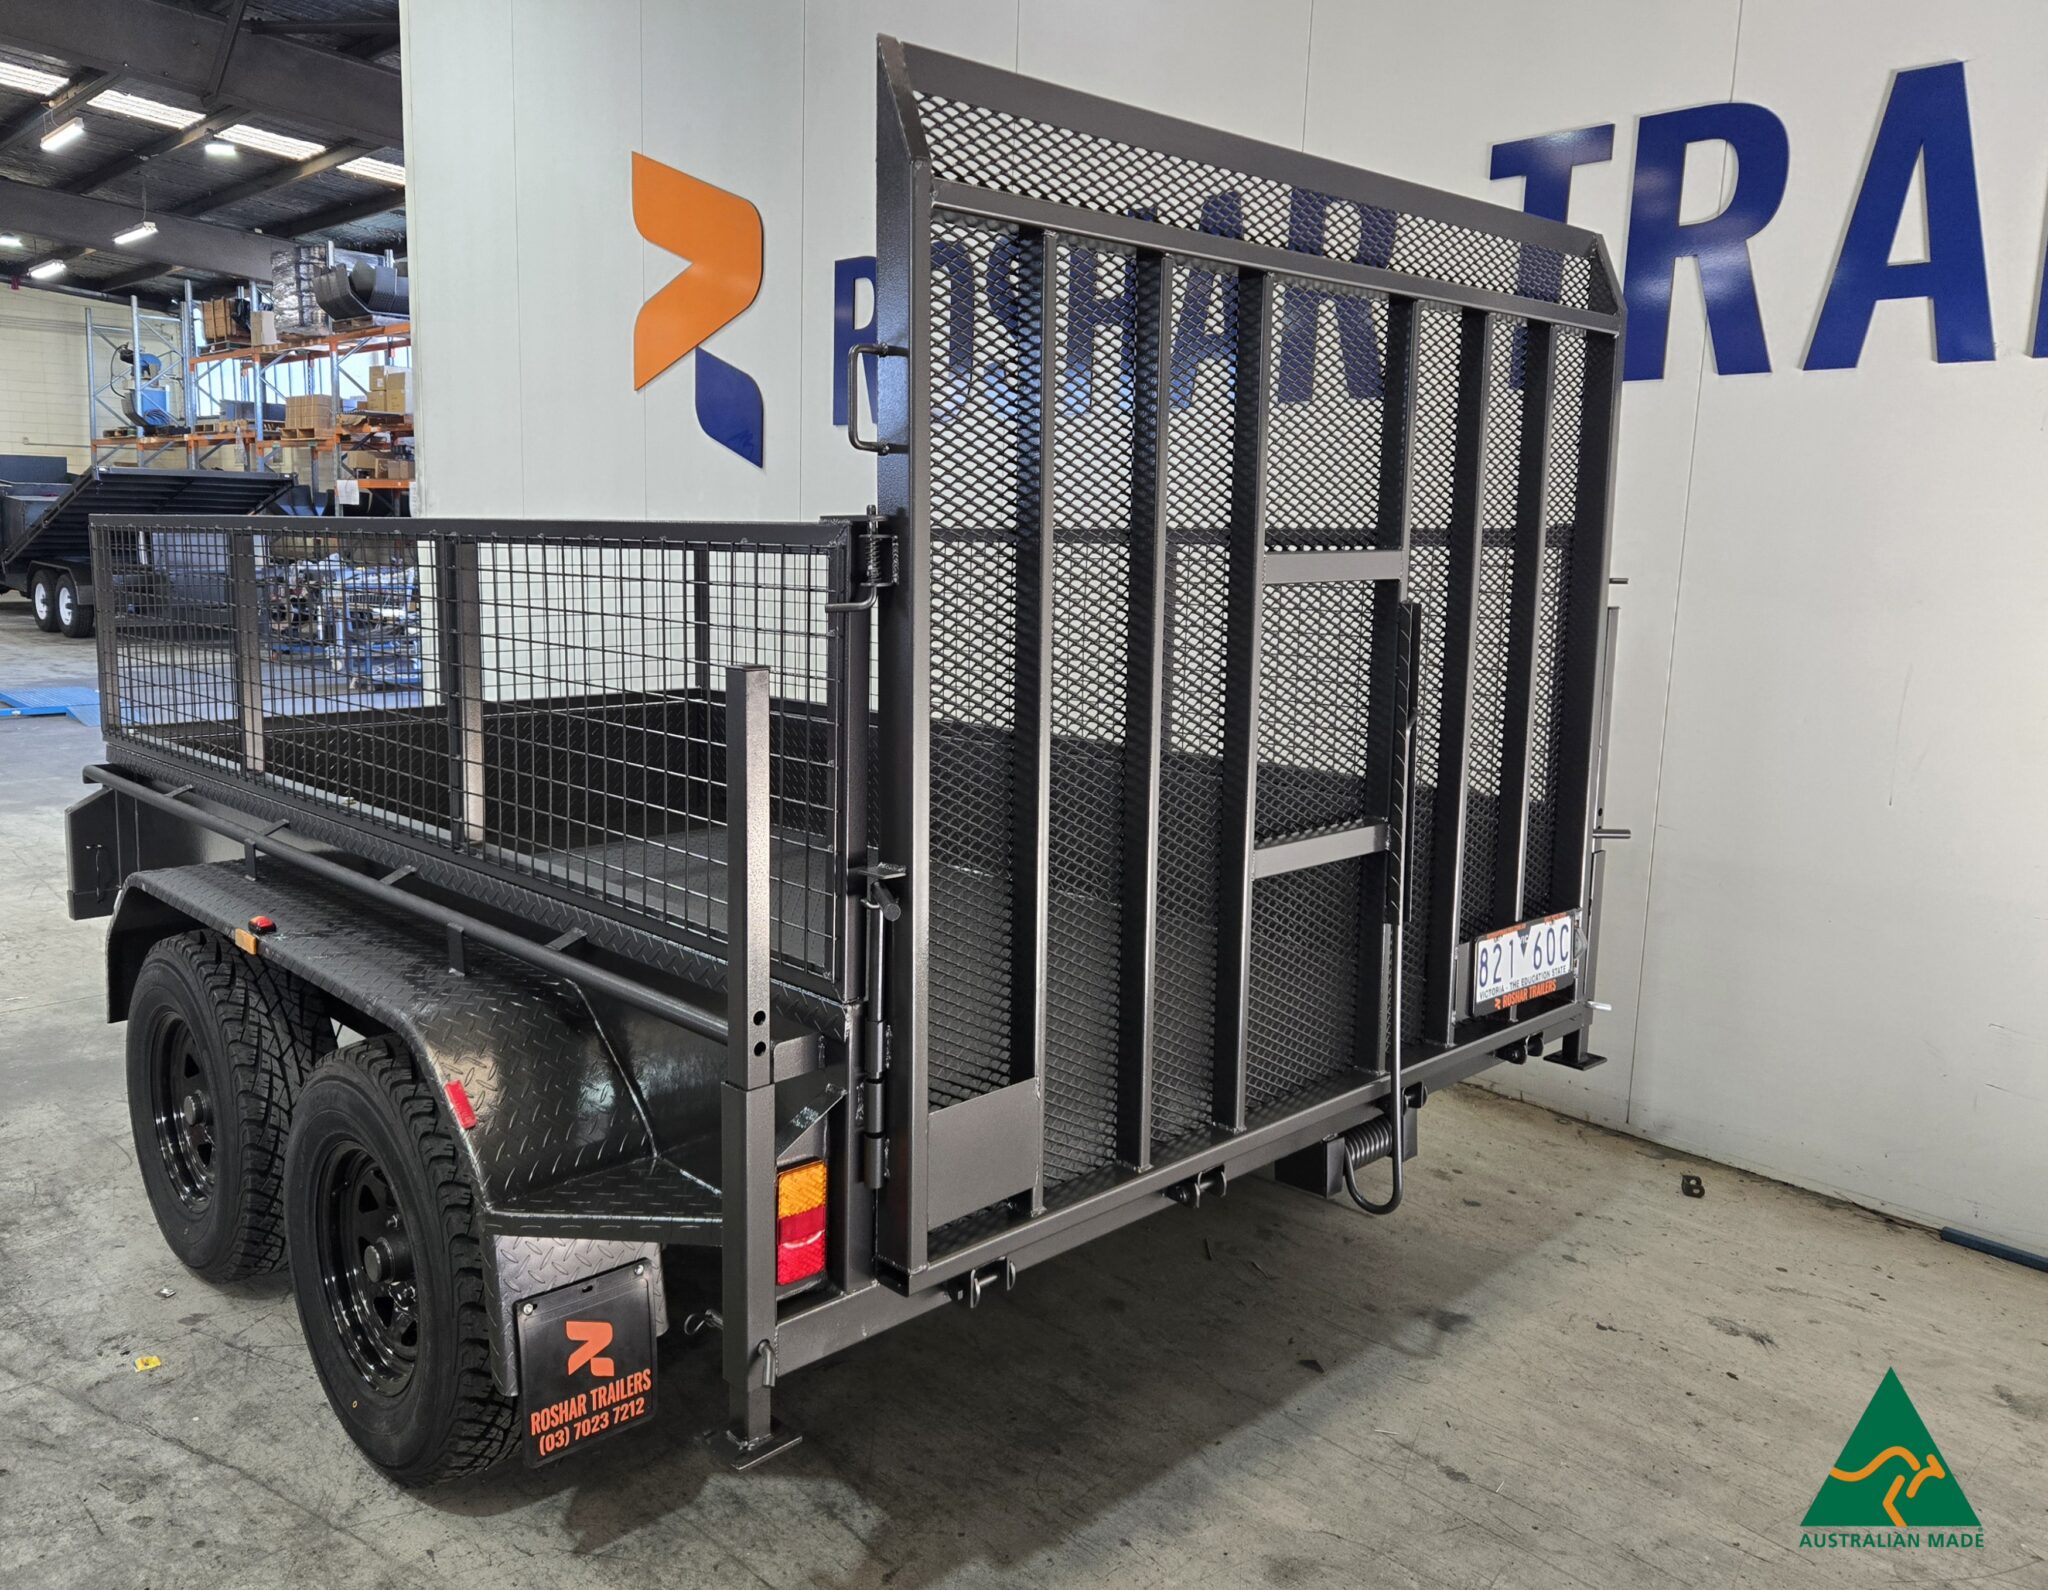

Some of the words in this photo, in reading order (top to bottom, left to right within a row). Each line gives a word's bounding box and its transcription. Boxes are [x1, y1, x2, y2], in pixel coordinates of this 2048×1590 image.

[1489, 60, 2048, 389] TRA
[1479, 939, 1515, 987] 821
[1533, 924, 1569, 970] 60C
[1479, 985, 1505, 1000] VICTORIA
[1510, 980, 1520, 989] THE
[1521, 969, 1551, 986] EDUCATION
[1551, 965, 1567, 976] STATE
[1502, 988, 1528, 1008] ROSHAR
[1529, 979, 1557, 998] TRAILERS
[530, 1393, 588, 1436] ROSHAR
[590, 1368, 652, 1415] TRAILERS
[539, 1427, 571, 1456] (03)
[574, 1411, 610, 1441] 7023
[613, 1397, 645, 1425] 7212
